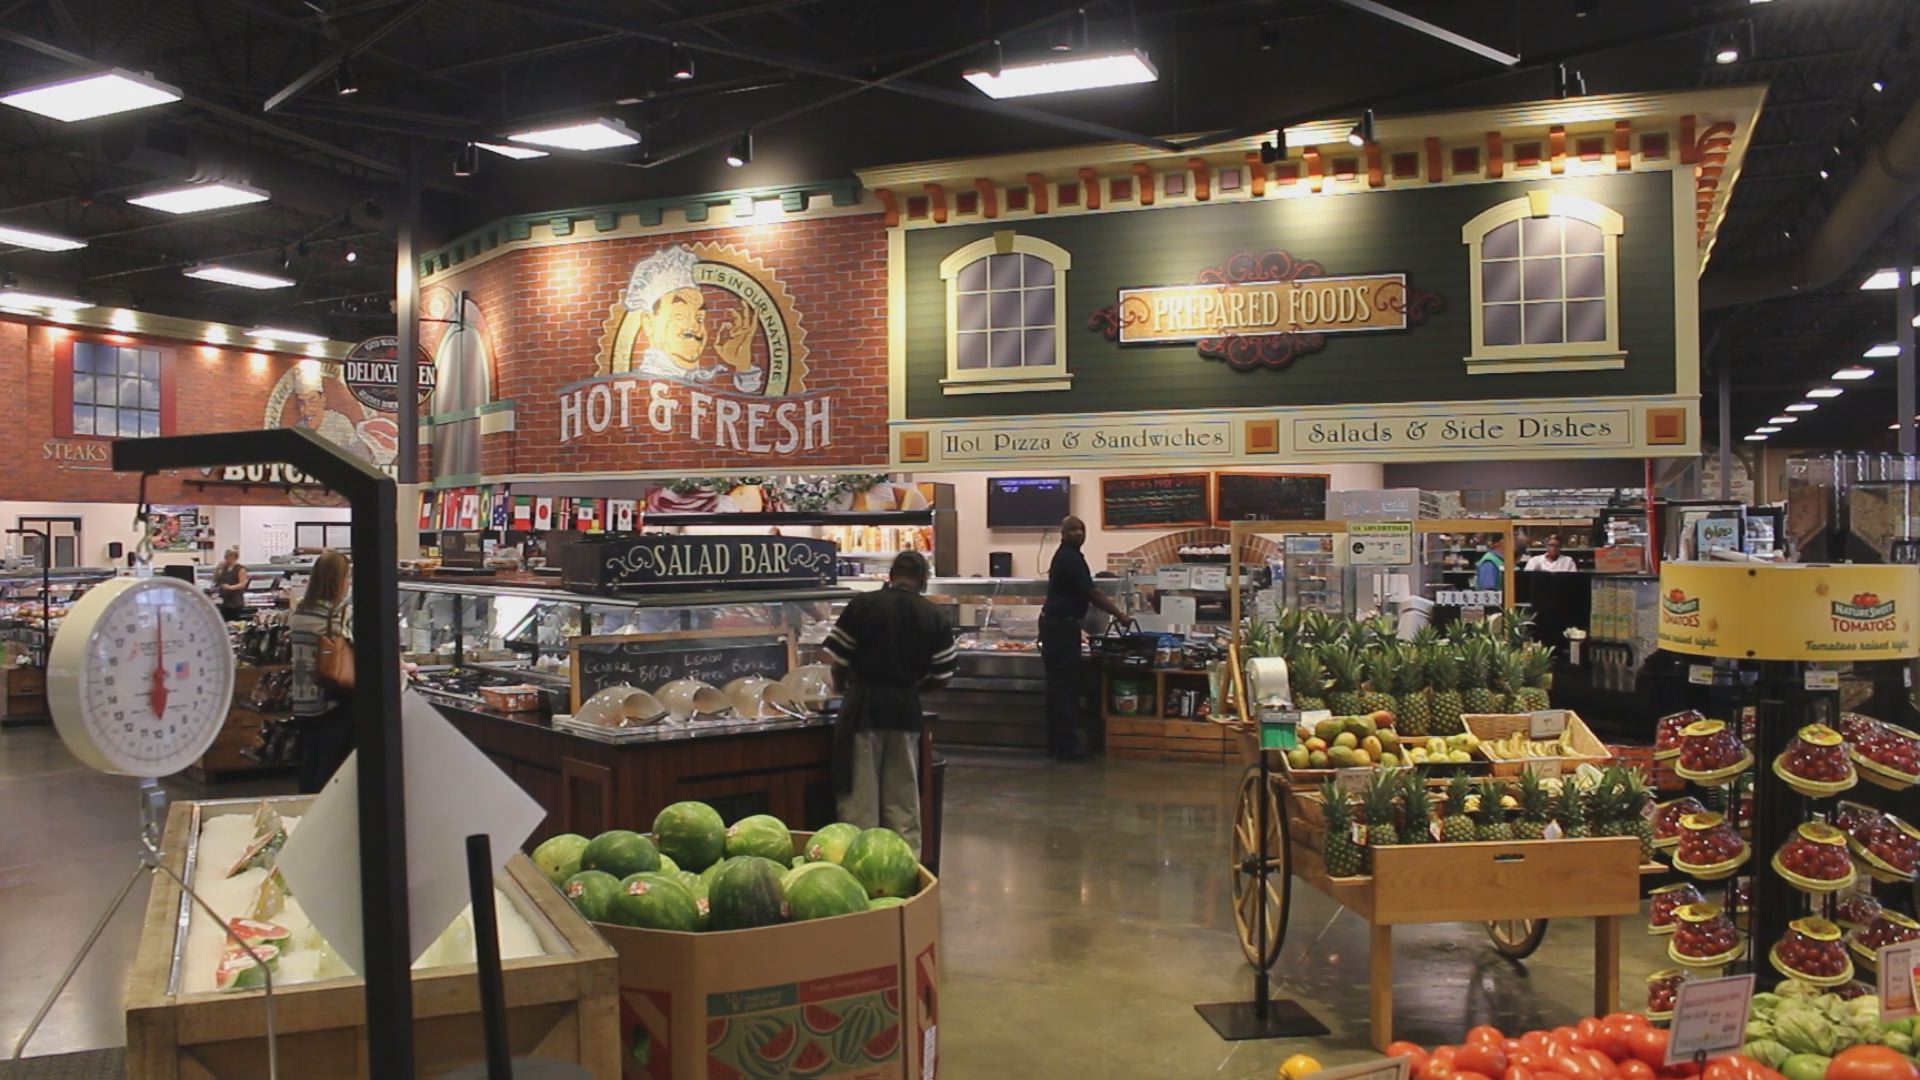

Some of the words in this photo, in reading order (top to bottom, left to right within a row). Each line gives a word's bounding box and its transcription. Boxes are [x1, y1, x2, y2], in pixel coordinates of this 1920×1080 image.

[1151, 290, 1280, 332] PREPARED
[1287, 285, 1371, 325] FOODS
[700, 268, 726, 283] IT'S
[728, 275, 744, 290] IN
[744, 286, 769, 316] OUR
[765, 316, 784, 382] NATURE
[346, 361, 436, 385] DELICATEN
[559, 380, 637, 443] HOT
[649, 383, 680, 432] &
[690, 390, 831, 454] FRESH
[1308, 421, 1393, 443] Salads
[1406, 420, 1429, 440] &
[1441, 418, 1505, 440] Side
[1518, 416, 1612, 438] Dishes
[42, 441, 108, 462] STEAKS
[945, 435, 982, 453] Hot
[993, 432, 1051, 452] Pizza
[1062, 431, 1081, 450] &
[1091, 427, 1225, 449] Sandwiches
[652, 543, 731, 577] SALAD
[740, 542, 790, 575] BAR
[1830, 616, 1897, 633] TOMATOES
[1805, 640, 1857, 651] Tomatoes
[1860, 640, 1889, 650] raised
[639, 664, 672, 682] BBQ
